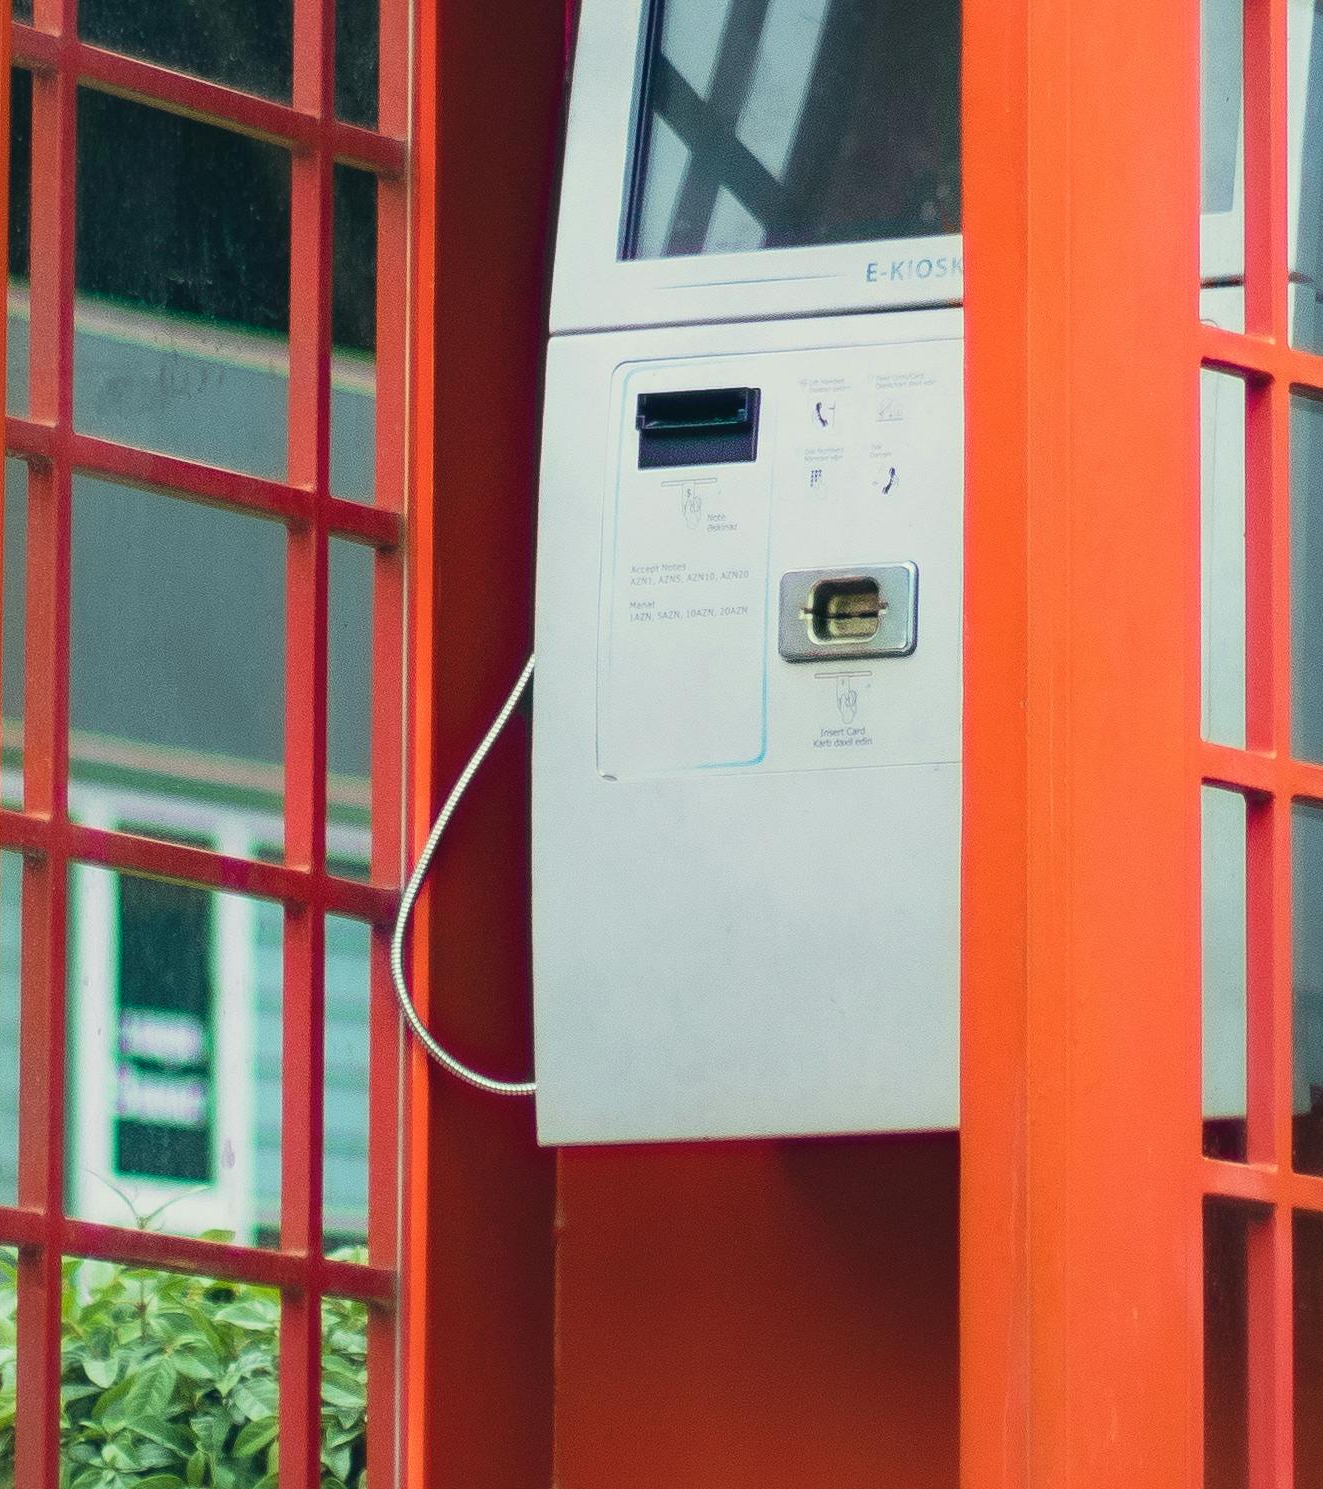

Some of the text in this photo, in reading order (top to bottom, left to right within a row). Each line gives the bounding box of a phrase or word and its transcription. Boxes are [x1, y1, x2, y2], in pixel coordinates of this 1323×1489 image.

[630, 563, 686, 575] Accept Notes
[720, 570, 750, 580] AZN20
[719, 606, 749, 616] 20AZN
